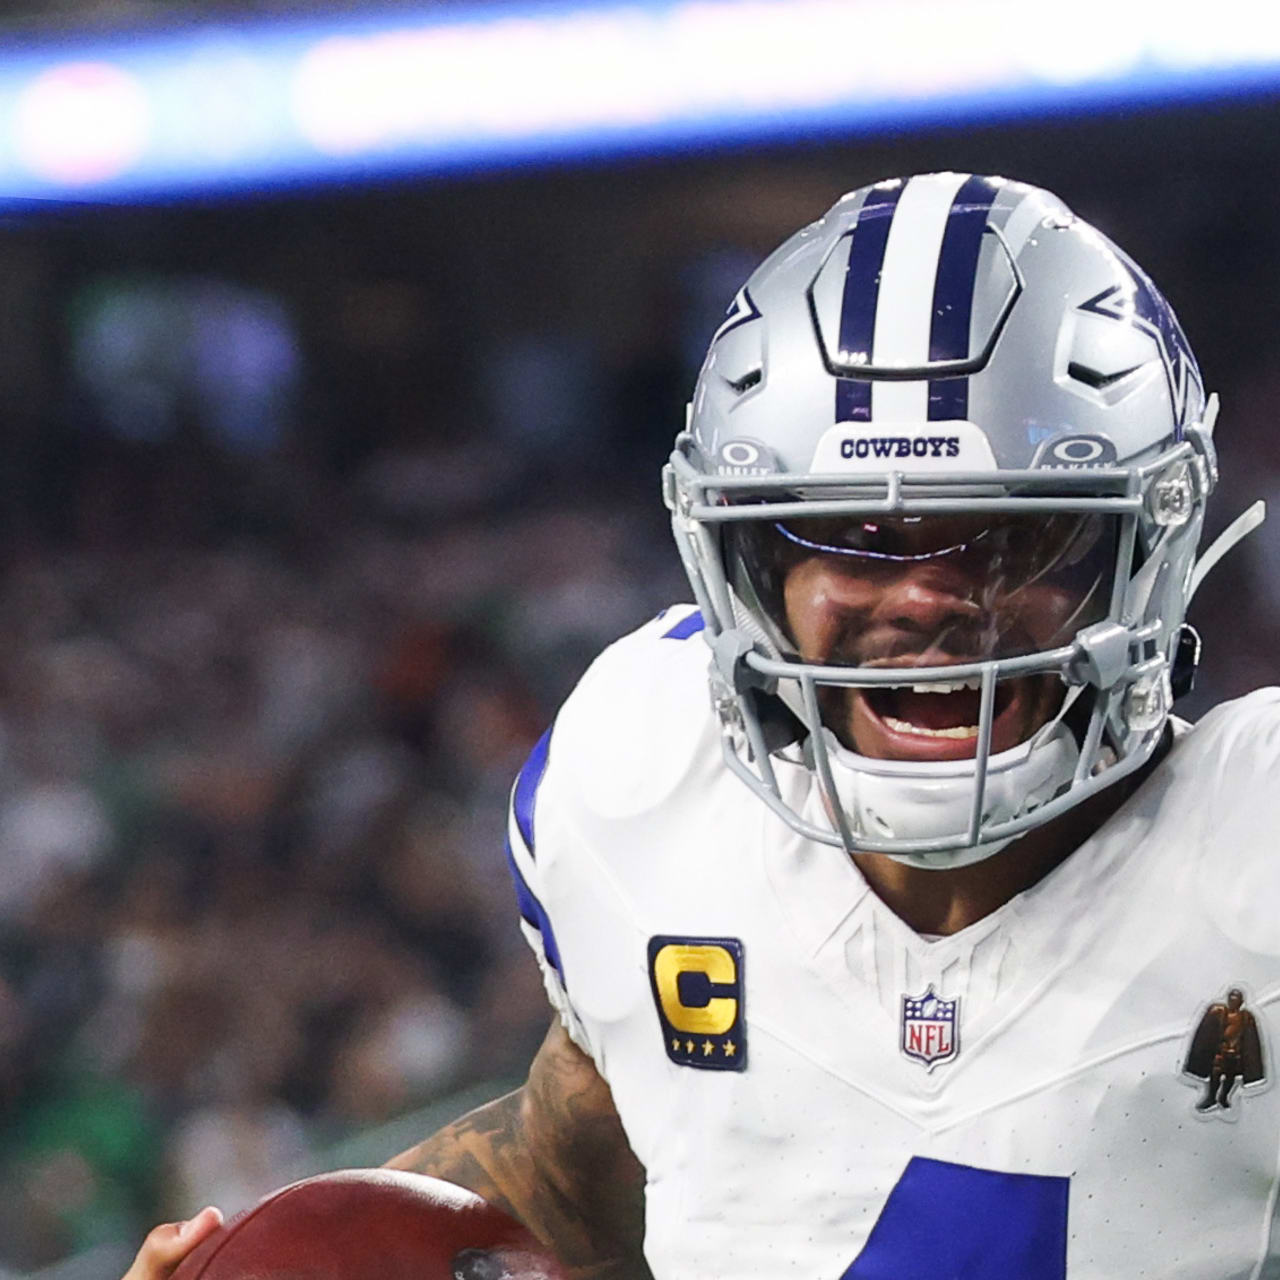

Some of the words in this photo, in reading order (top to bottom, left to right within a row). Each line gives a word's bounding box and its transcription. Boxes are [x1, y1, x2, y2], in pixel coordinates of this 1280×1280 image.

[840, 436, 960, 460] COWBOYS
[654, 945, 737, 1035] C
[907, 1022, 953, 1055] NFL
